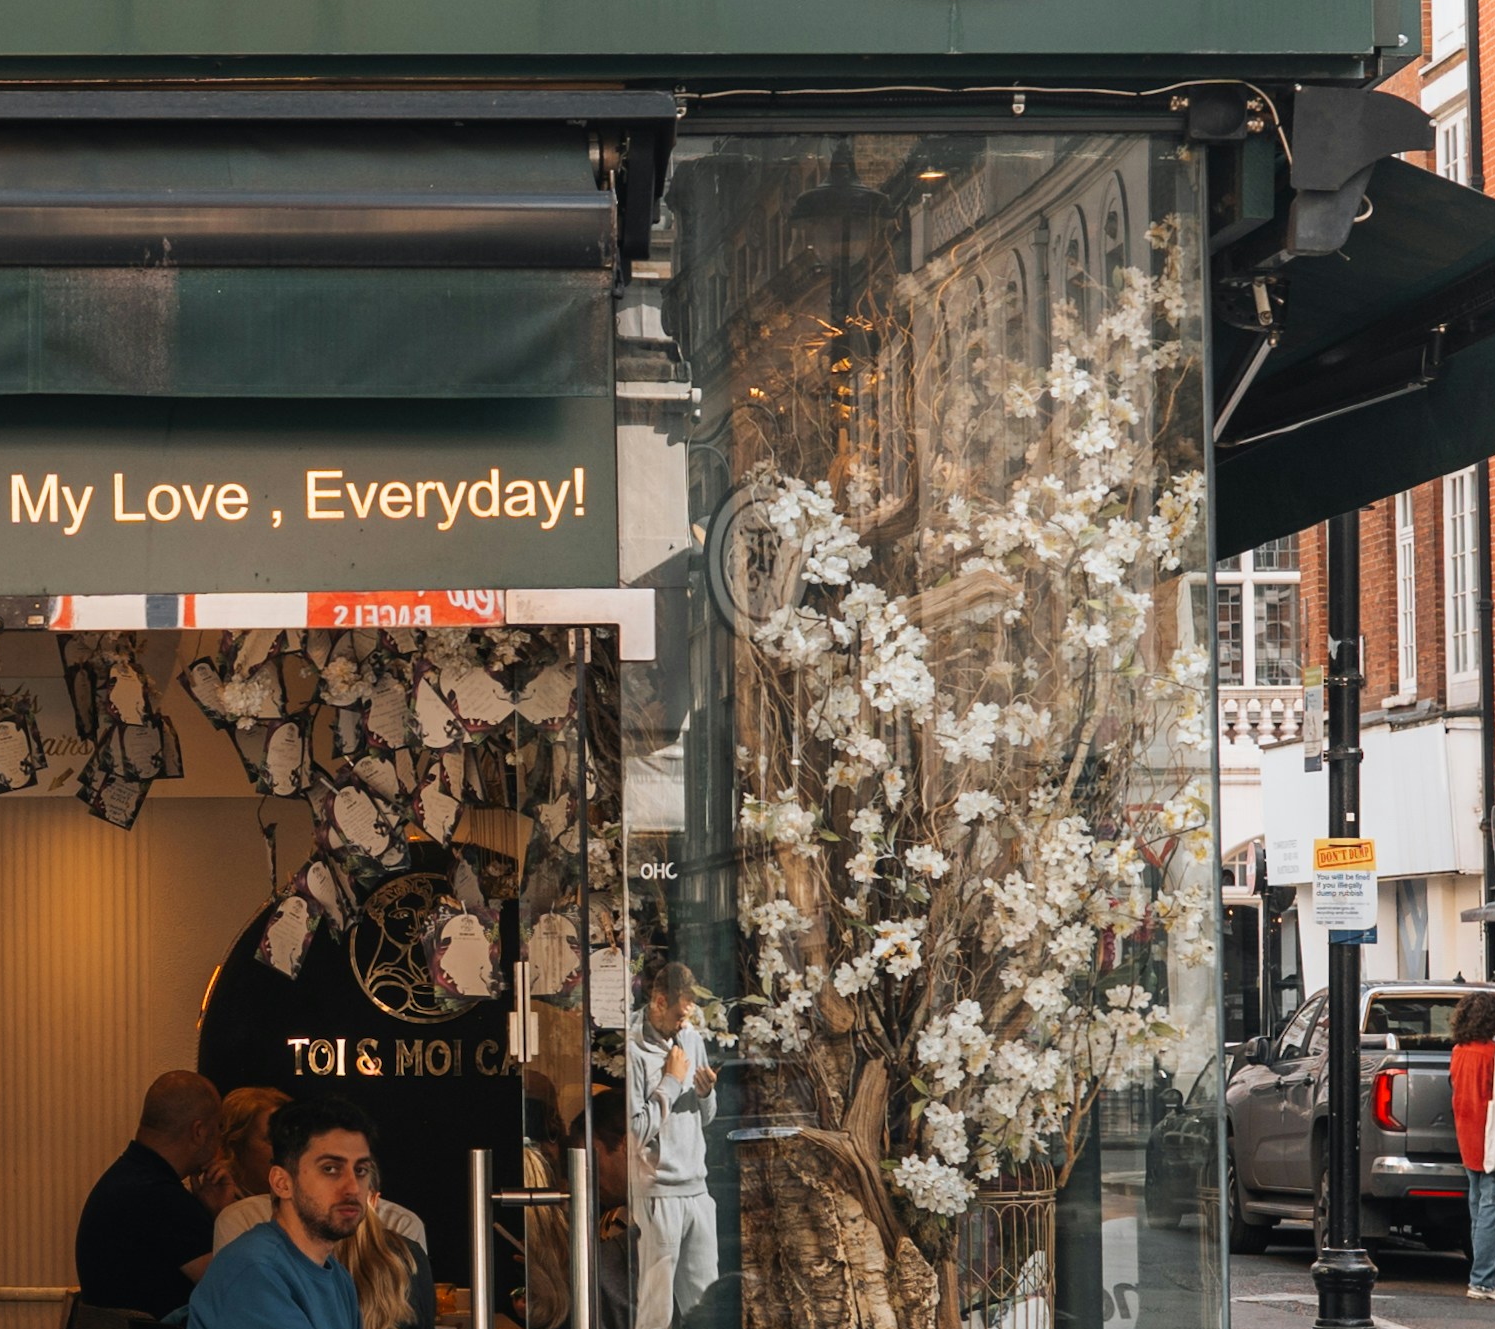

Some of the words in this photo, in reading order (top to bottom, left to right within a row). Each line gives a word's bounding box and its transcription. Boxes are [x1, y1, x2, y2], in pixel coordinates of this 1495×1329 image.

[10, 472, 94, 535] My
[111, 471, 250, 522] Love
[305, 466, 588, 530] Everyday!
[1320, 849, 1348, 864] DON'T
[1349, 846, 1369, 860] DUMP
[287, 1037, 347, 1077] TOI
[355, 1038, 384, 1077] &
[395, 1038, 462, 1077] MOI
